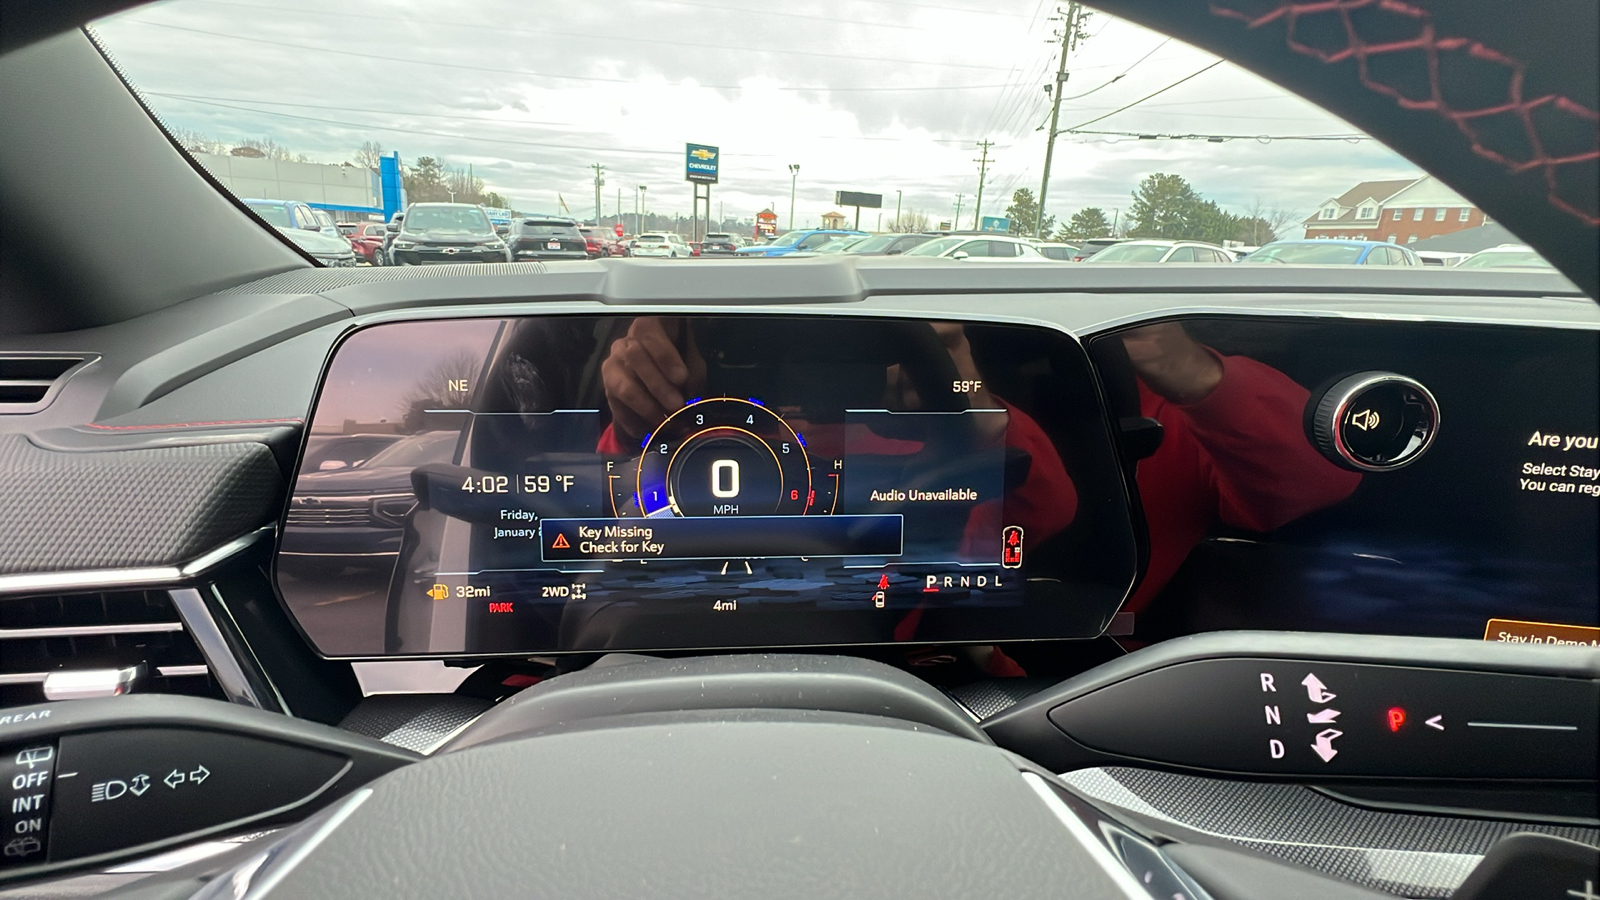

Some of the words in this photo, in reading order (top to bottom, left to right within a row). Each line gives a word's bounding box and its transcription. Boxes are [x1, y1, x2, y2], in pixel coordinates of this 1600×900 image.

[689, 162, 716, 170] CHEVROLET
[448, 380, 468, 392] NE
[952, 381, 982, 392] 59°F
[696, 415, 704, 425] 3
[746, 415, 754, 425] 4
[1528, 430, 1560, 447] Are
[1562, 435, 1598, 451] you
[660, 444, 668, 454] 2
[782, 444, 790, 453] 5
[607, 462, 614, 471] F
[834, 460, 842, 470] H
[1522, 462, 1567, 476] Select
[1569, 465, 1600, 480] Stay
[461, 476, 509, 493] 4:02
[524, 475, 550, 493] 59
[712, 459, 740, 498] 0
[1520, 478, 1546, 491] You
[1549, 482, 1575, 493] can
[653, 492, 658, 501] 1
[790, 490, 798, 500] 6
[870, 489, 905, 501] Audio
[909, 489, 977, 501] Unavailable
[500, 510, 538, 521] Friday,
[713, 505, 739, 514] MPH
[494, 527, 535, 539] January
[579, 526, 602, 539] Key
[604, 526, 652, 539] Missing
[580, 542, 618, 553] Check
[621, 541, 638, 552] for
[642, 542, 664, 554] Key
[926, 576, 937, 588] P
[944, 576, 952, 587] R
[960, 576, 970, 587] N
[977, 576, 987, 586] D
[995, 576, 1002, 586] L
[456, 585, 491, 597] 32mi
[542, 586, 569, 597] 2WD
[489, 602, 513, 613] PARK
[713, 600, 737, 611] 4mi
[1497, 632, 1527, 644] Stay
[1530, 635, 1542, 644] in
[1260, 673, 1276, 692] R
[0, 710, 51, 724] REAR
[1265, 706, 1281, 726] N
[1388, 708, 1406, 731] P
[1270, 740, 1284, 759] D
[12, 771, 48, 790] OFF
[12, 794, 44, 814] INT
[15, 818, 41, 834] ON
